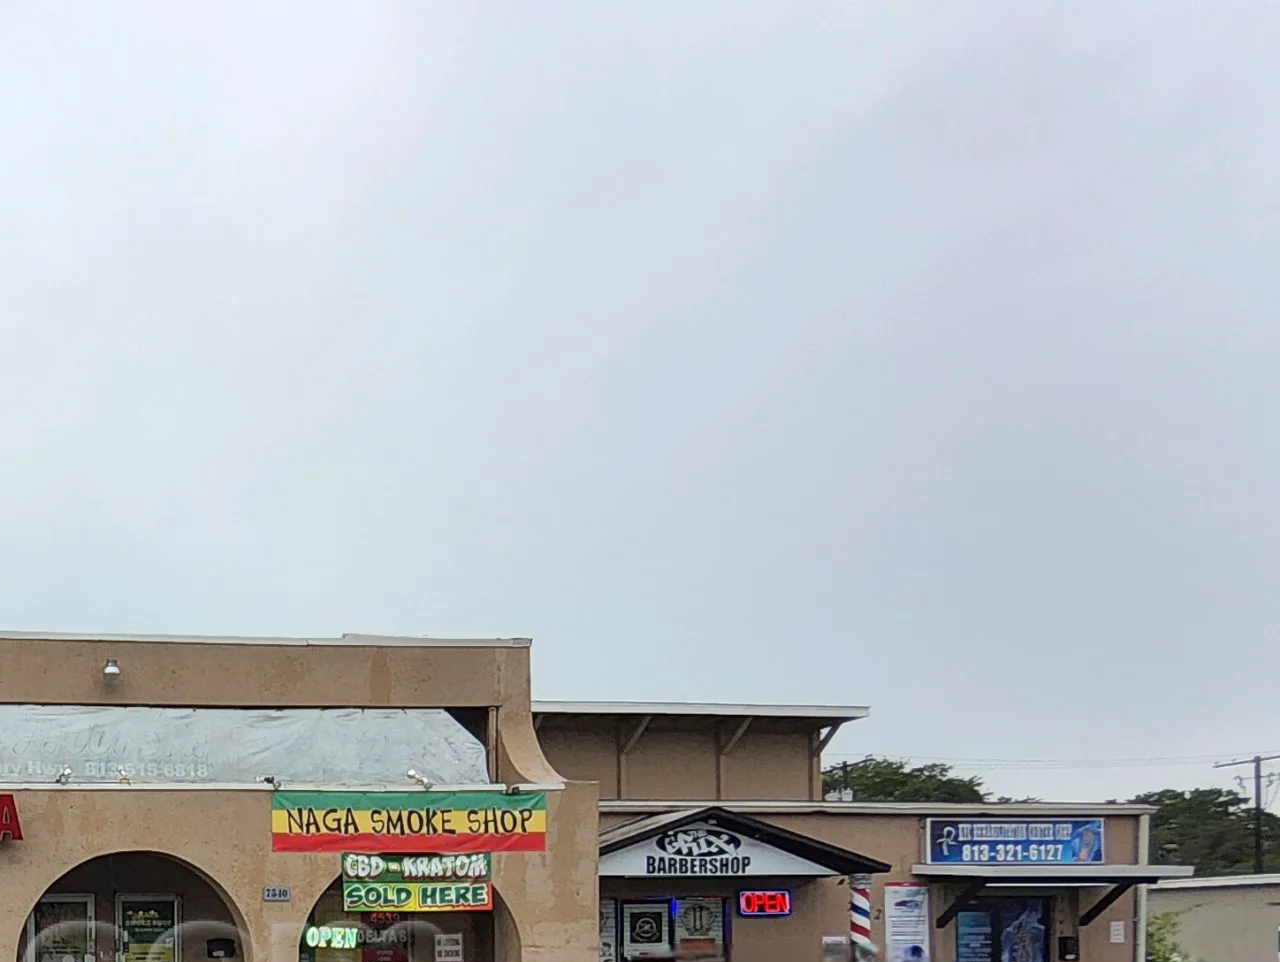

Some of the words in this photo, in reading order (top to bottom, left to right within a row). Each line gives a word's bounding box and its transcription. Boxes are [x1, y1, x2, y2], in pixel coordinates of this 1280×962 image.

[286, 807, 360, 835] NAGA
[371, 808, 457, 835] SMOKE
[469, 807, 533, 834] SHOP
[962, 844, 1064, 861] 813-321-6127
[345, 855, 386, 878] CBD
[402, 854, 489, 878] KRATOM
[646, 856, 751, 874] BARBERSHOP
[345, 885, 413, 907] SOLD
[420, 884, 488, 905] HERE
[741, 892, 789, 913] OPEN
[306, 926, 359, 949] OPEN
